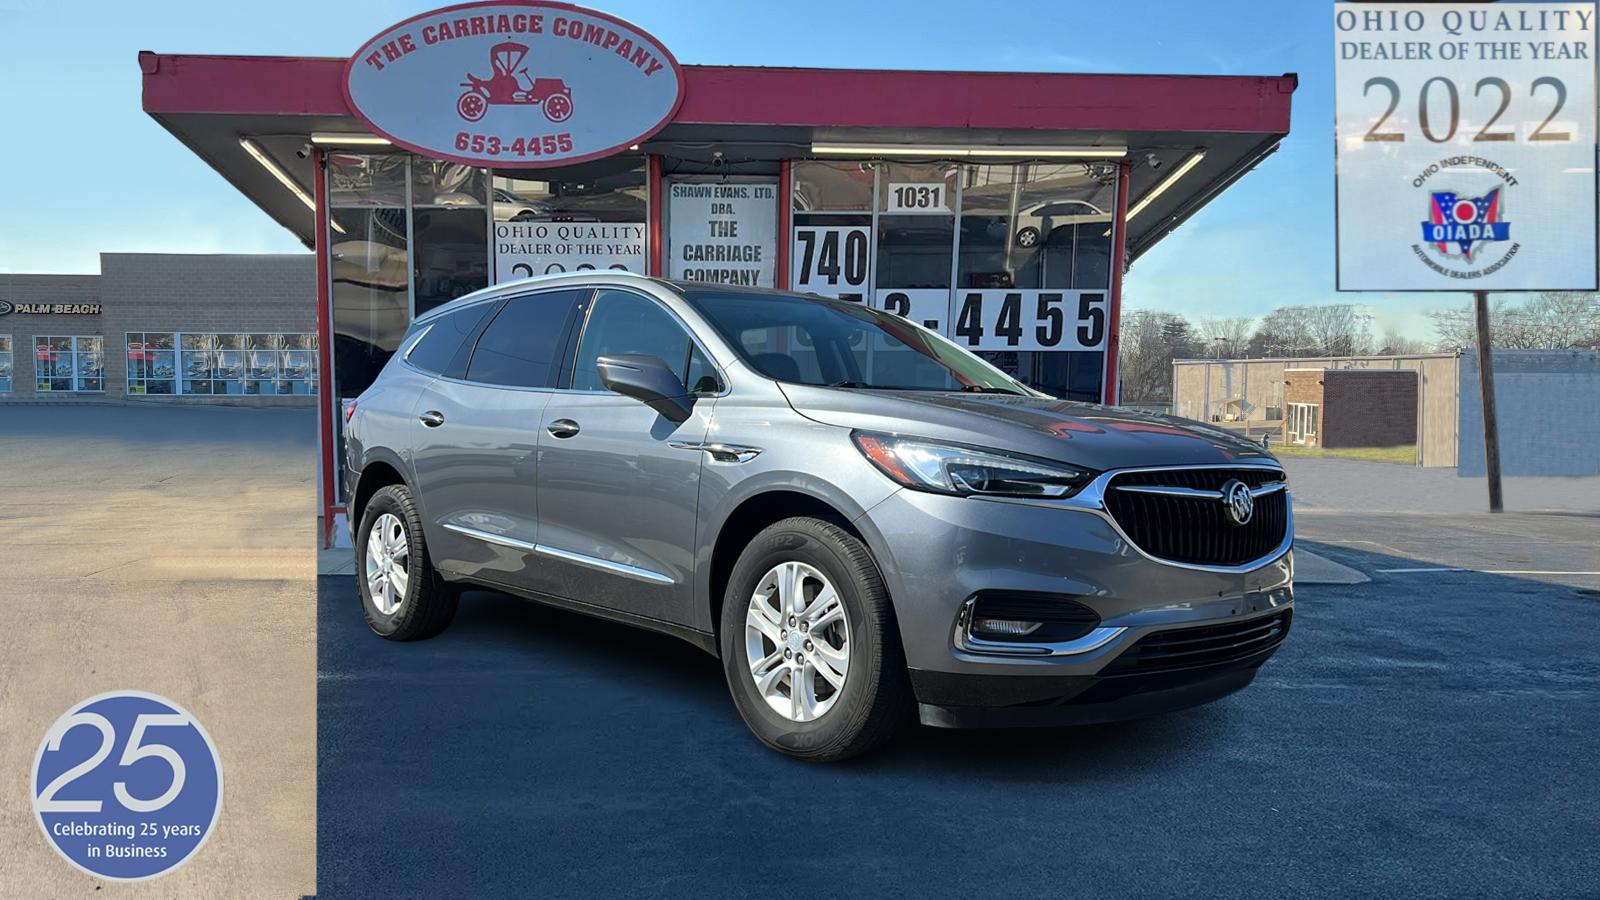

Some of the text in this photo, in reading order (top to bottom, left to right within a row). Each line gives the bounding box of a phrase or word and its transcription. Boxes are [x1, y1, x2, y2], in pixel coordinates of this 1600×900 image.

[1336, 10, 1593, 36] OHIO QUALITY
[366, 14, 664, 77] THE CARRIAGE COMPANY
[1340, 41, 1589, 60] DEALER OF THE YEAR
[1362, 76, 1571, 144] 2022
[454, 132, 573, 157] 653-4455
[1412, 155, 1519, 189] OHIO INDEPENDENT
[672, 186, 712, 199] SHAWN
[754, 187, 775, 200] LTD.
[894, 186, 940, 208] 1031
[711, 203, 736, 215] DBA.
[496, 225, 644, 241] OHIO QUALITY
[708, 220, 738, 238] THE
[1432, 224, 1495, 241] OIADA
[499, 243, 641, 255] DEALER OF THE YEAR
[683, 244, 762, 262] CARRIAGE
[797, 230, 867, 286] 740
[1411, 242, 1521, 280] AUTOMOBILE DEALERS ASSOCIATION
[683, 268, 760, 286] COMPANY
[14, 303, 100, 314] PALM BEACH
